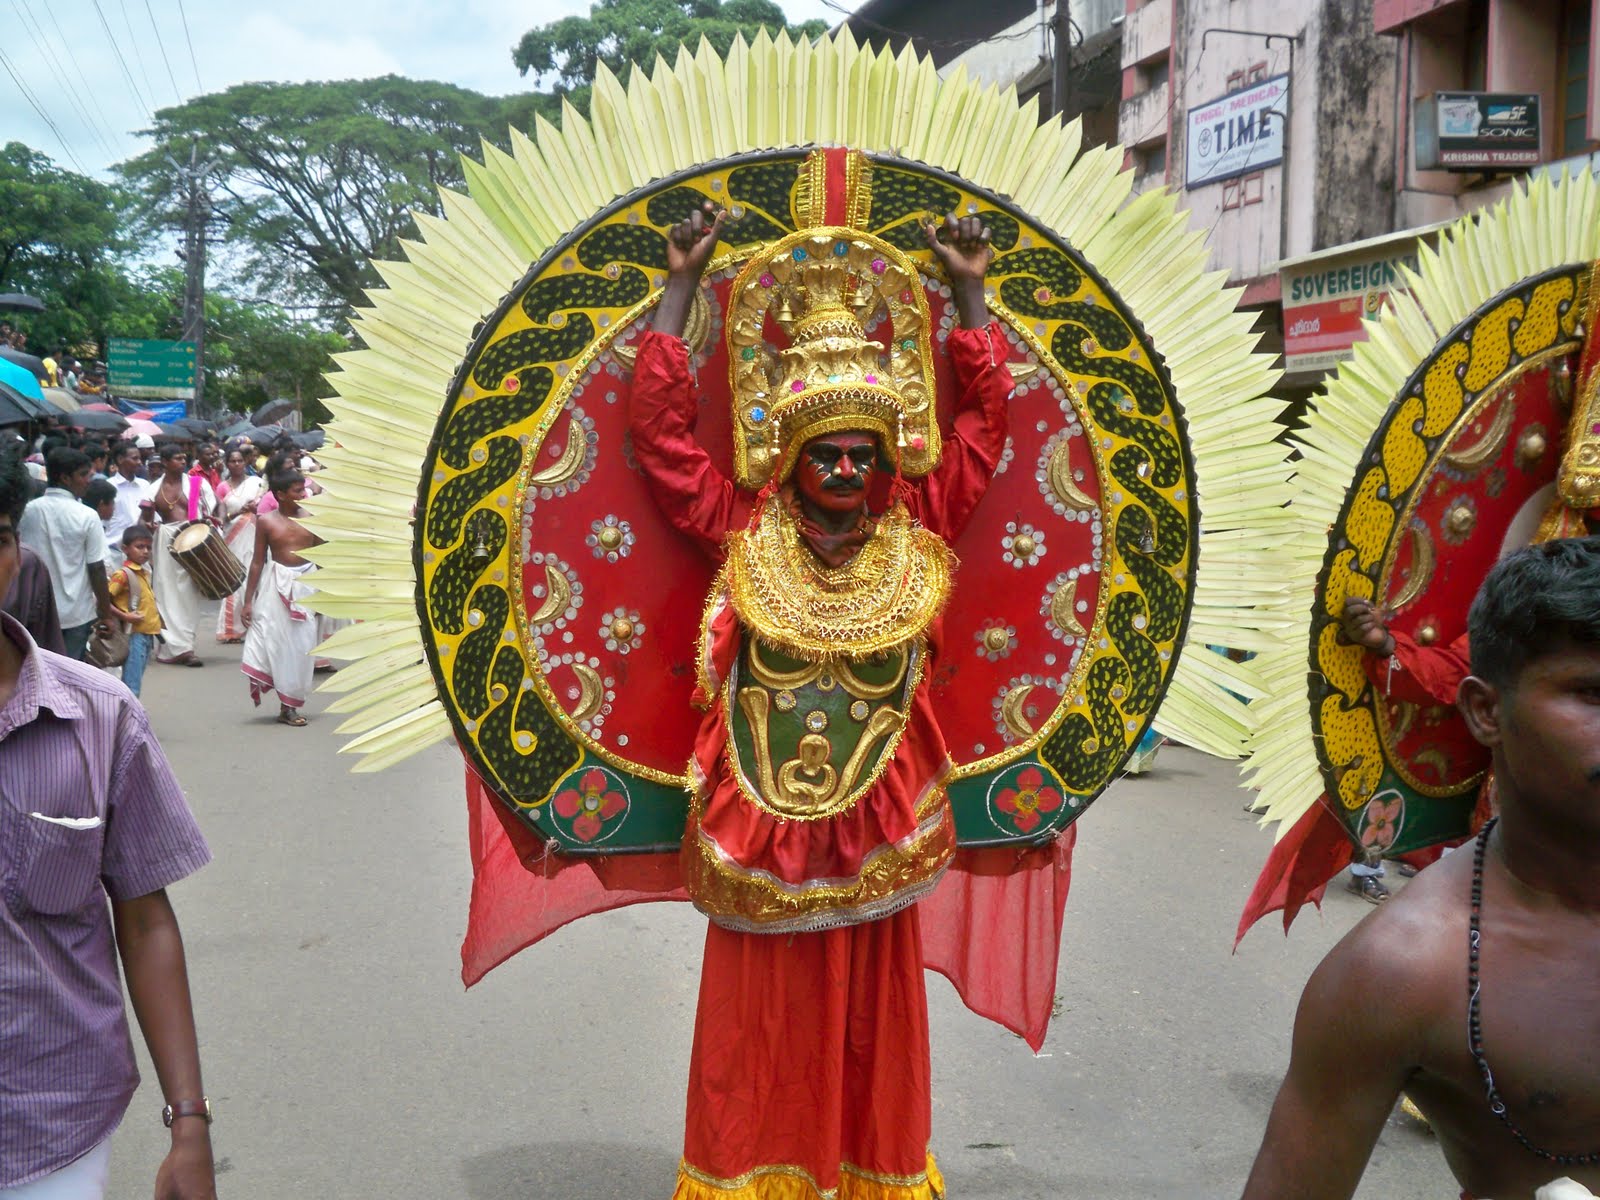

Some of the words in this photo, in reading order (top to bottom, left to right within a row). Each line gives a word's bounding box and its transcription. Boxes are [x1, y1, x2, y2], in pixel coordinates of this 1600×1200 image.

[1480, 128, 1536, 137] SONIC
[1442, 151, 1490, 163] KRISHNA
[1491, 152, 1538, 162] TRADERS
[1291, 259, 1397, 300] SOVEREIGN
